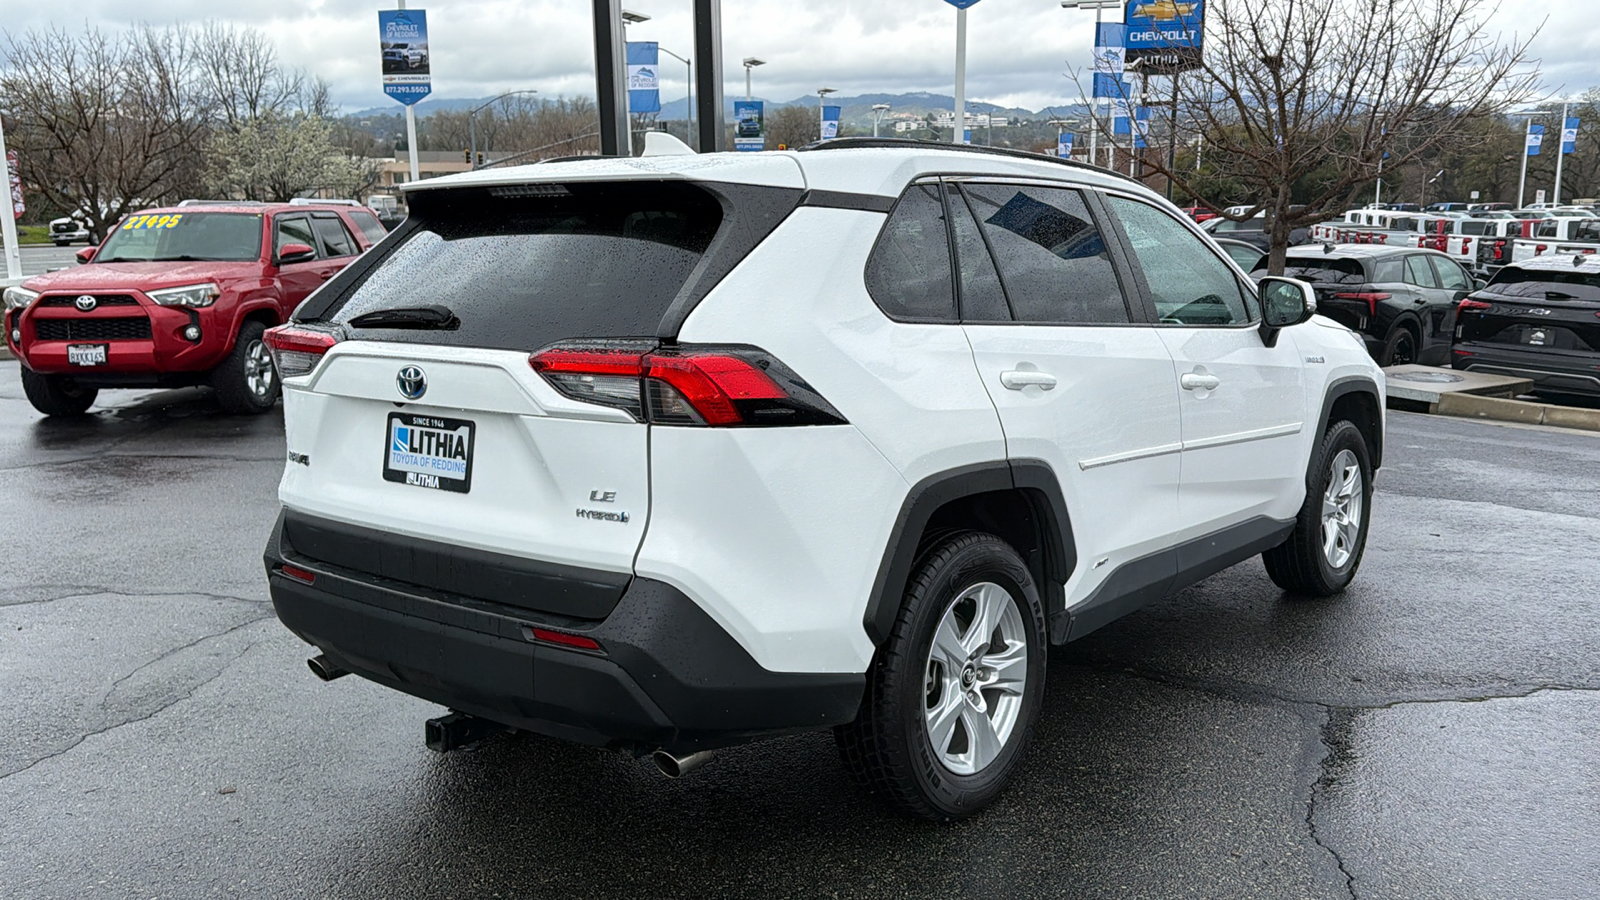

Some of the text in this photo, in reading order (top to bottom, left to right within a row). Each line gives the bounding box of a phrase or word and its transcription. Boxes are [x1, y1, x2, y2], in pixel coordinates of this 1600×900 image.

[386, 24, 418, 32] CHEVROLET
[1129, 30, 1197, 42] CHEVROLET
[1144, 54, 1179, 64] LITHIA
[123, 214, 183, 229] 27495
[412, 417, 445, 428] SINCE 1946
[409, 428, 466, 461] LITHIA
[392, 452, 466, 473] TOYOTA OF REDDING
[414, 472, 440, 489] LITHIA
[589, 490, 617, 503] LE
[576, 508, 621, 522] HYBRID
